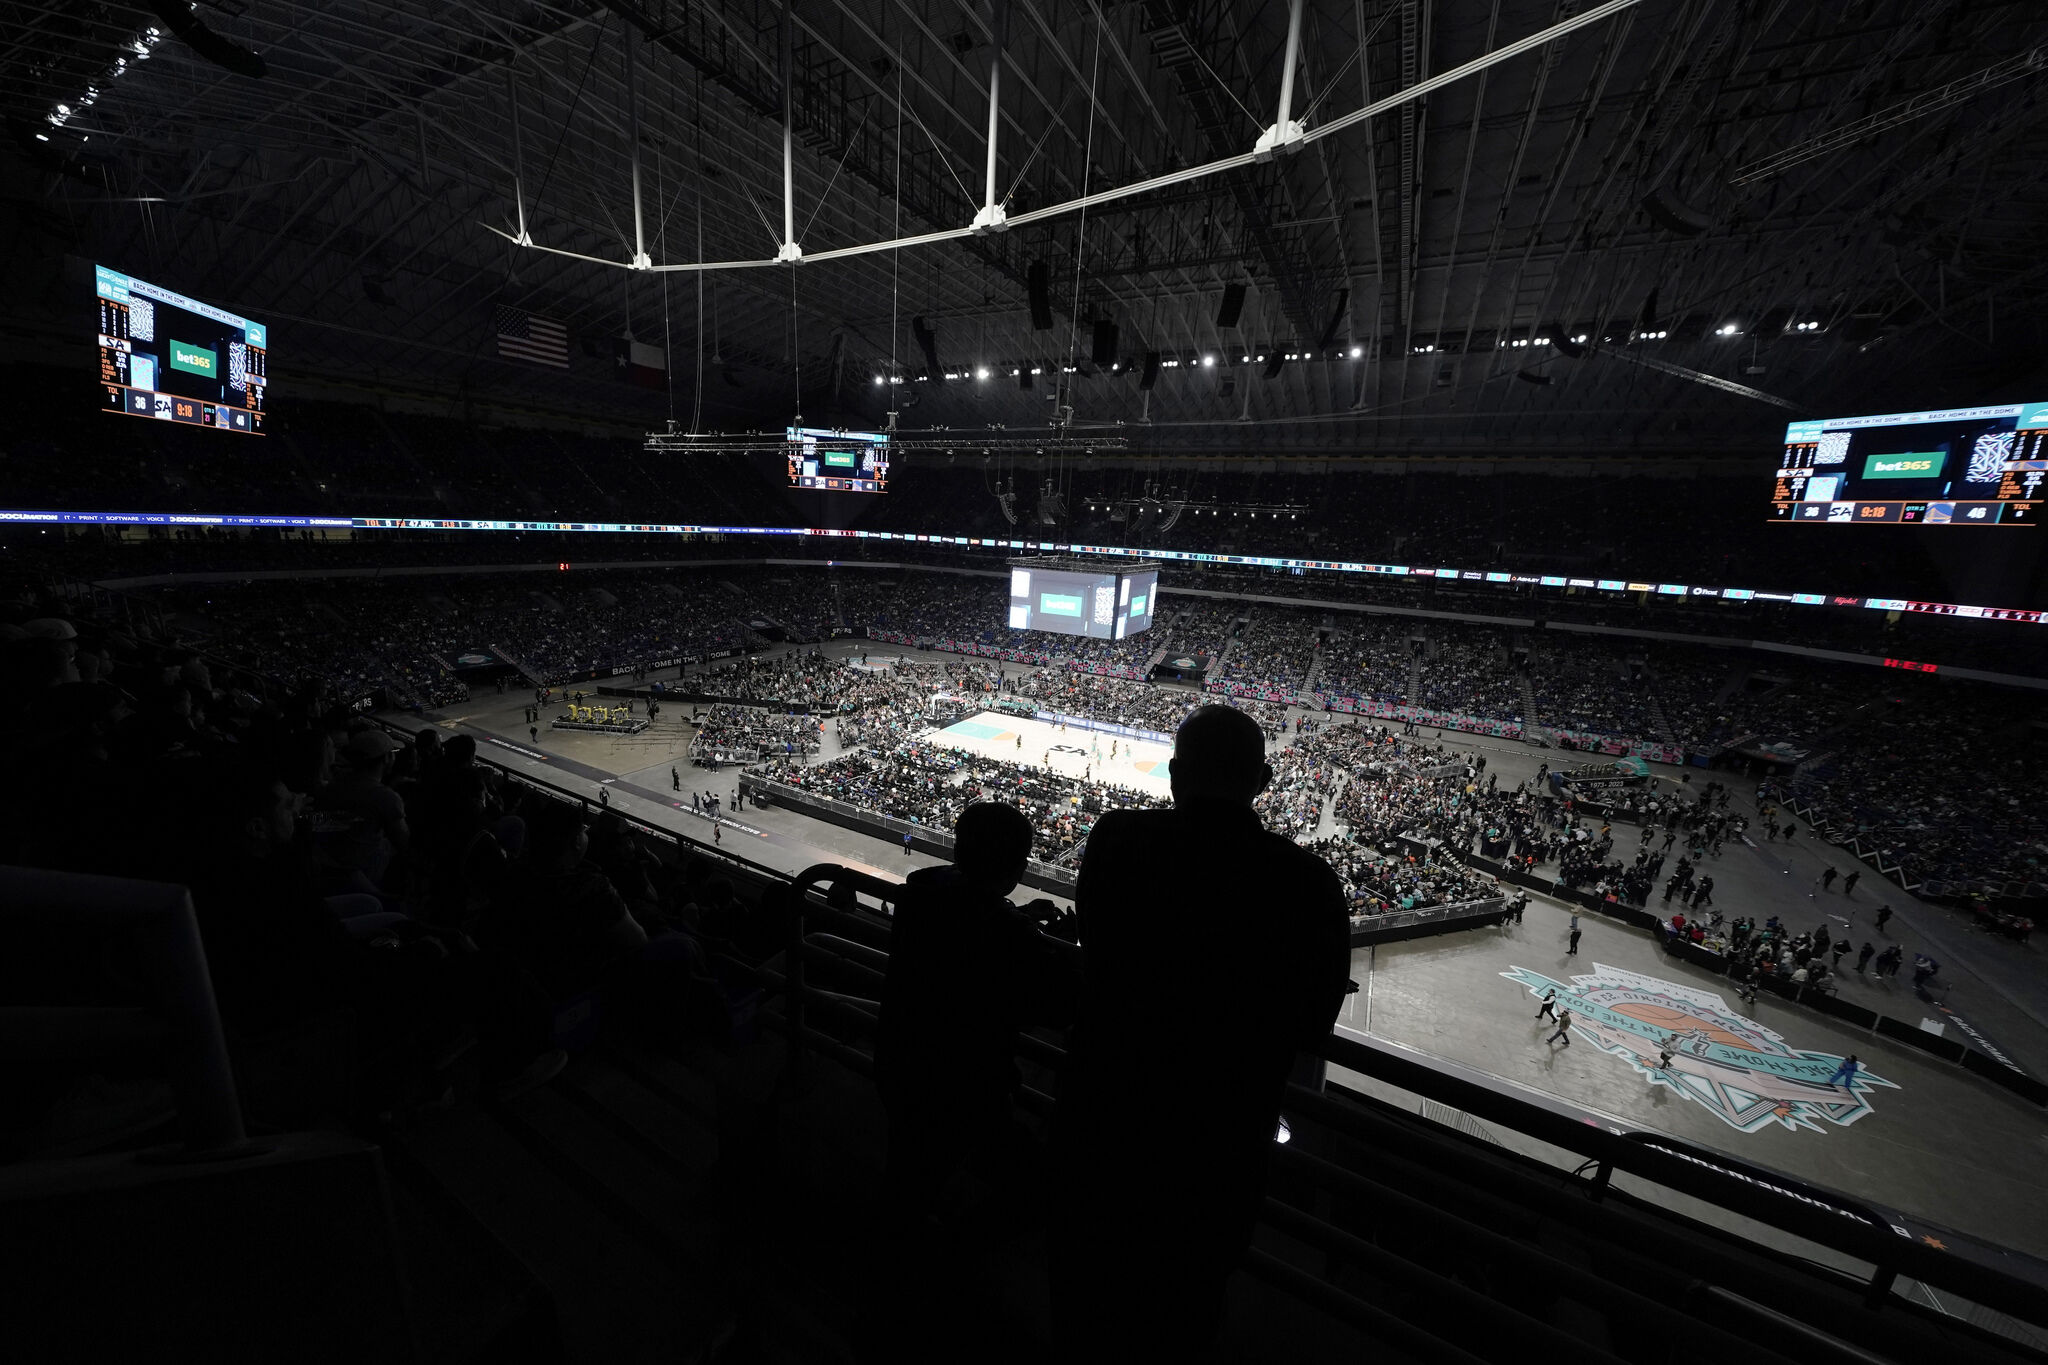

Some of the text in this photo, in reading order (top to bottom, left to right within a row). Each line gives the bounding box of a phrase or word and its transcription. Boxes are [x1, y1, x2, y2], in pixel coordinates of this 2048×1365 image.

[133, 281, 146, 291] BACK
[147, 286, 159, 296] HOME
[174, 296, 185, 305] DOME
[201, 306, 211, 314] BACK
[233, 317, 243, 325] DOME
[106, 337, 125, 350] SA
[176, 349, 210, 369] bet365
[107, 386, 119, 395] TOL
[134, 395, 146, 410] 36
[155, 400, 171, 413] SA
[176, 403, 193, 418] 9:18
[1994, 407, 2015, 415] DOME
[205, 414, 210, 422] 21
[1874, 461, 1931, 472] bet365
[1828, 507, 1852, 517] SA
[1860, 506, 1886, 518] 9:18
[1967, 507, 1987, 519] 46
[477, 521, 490, 529] SA
[1702, 588, 1718, 596] Frost
[1889, 601, 1903, 609] SA
[612, 665, 637, 676] BACK
[651, 659, 673, 669] OME
[710, 650, 731, 659] DOME
[1049, 744, 1088, 756] SA
[1623, 992, 1705, 1016] ANTONIO
[1711, 1019, 1757, 1040] SAN
[1948, 1015, 1983, 1039] BACK
[1561, 995, 1835, 1077] BACK HOME IN THE DOM
